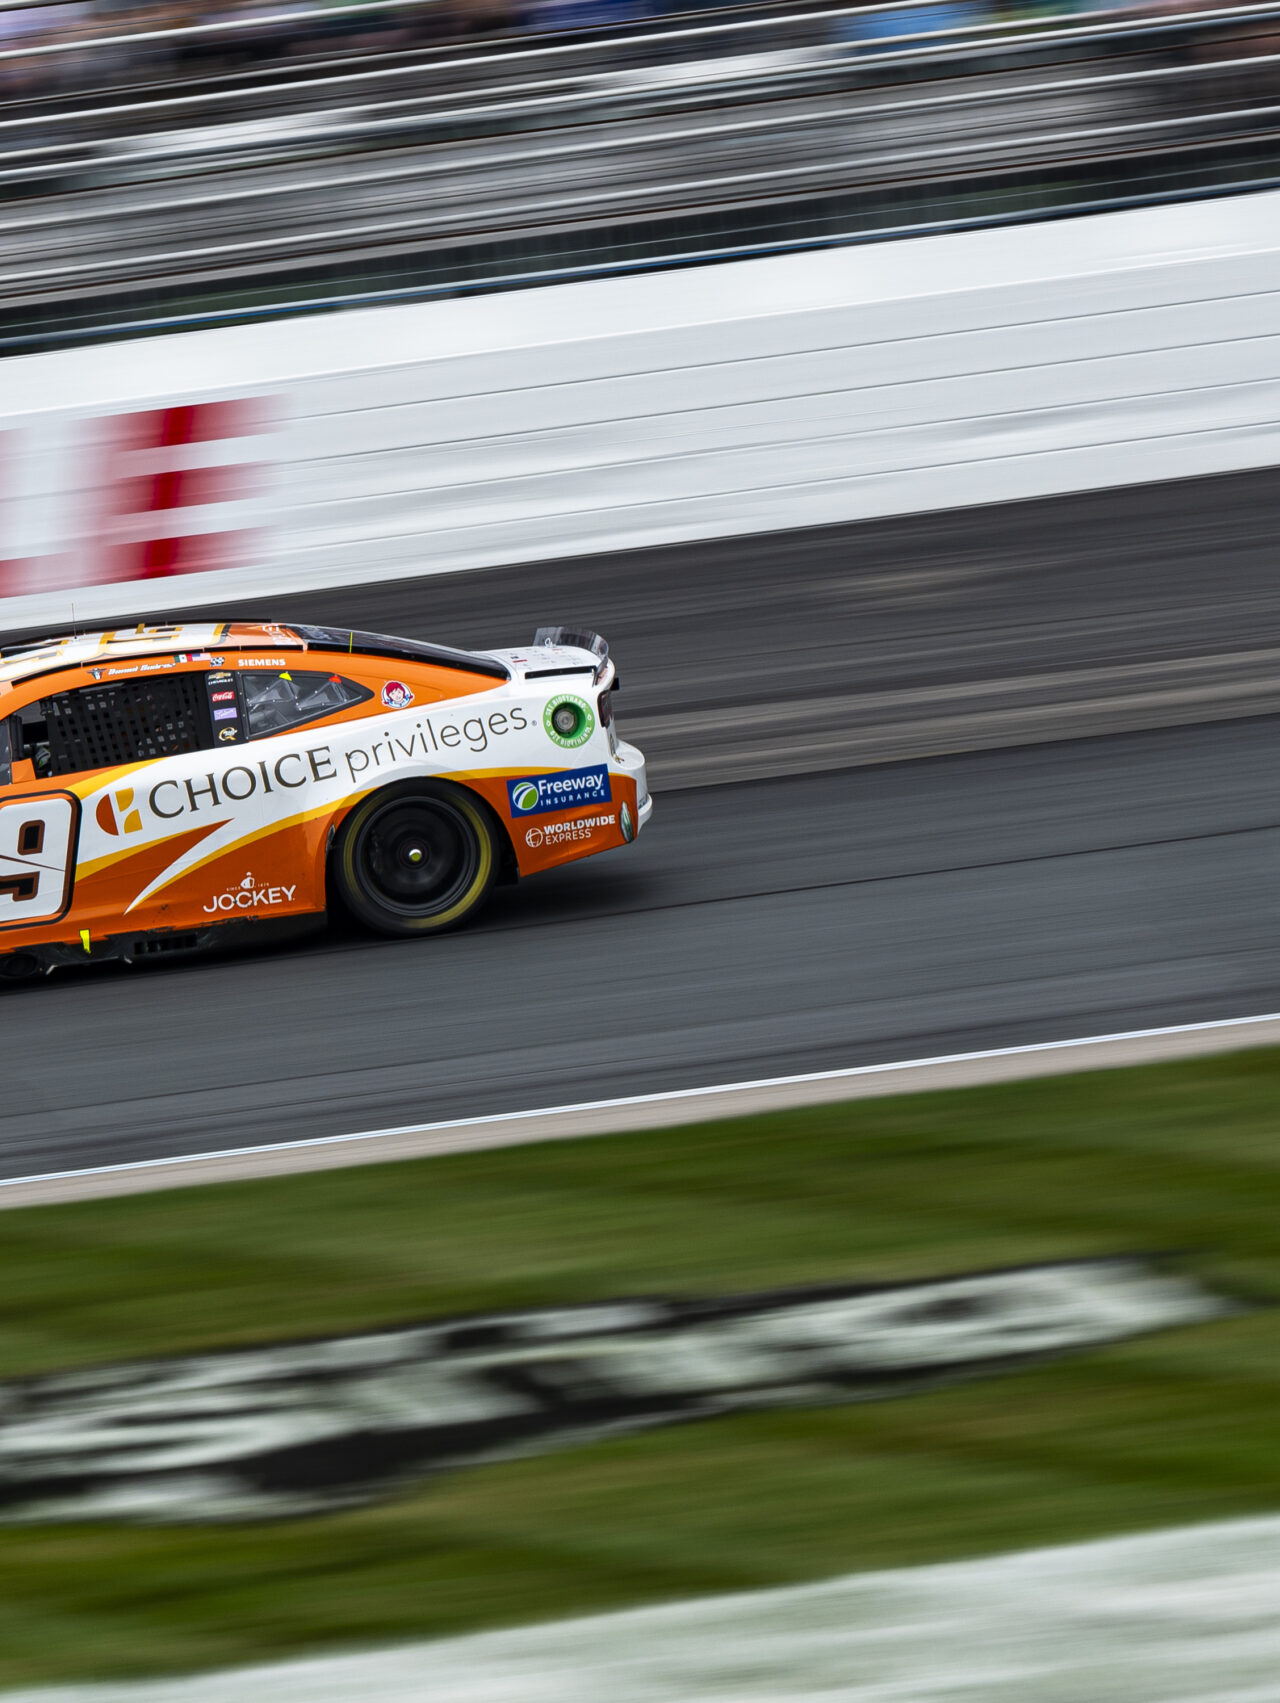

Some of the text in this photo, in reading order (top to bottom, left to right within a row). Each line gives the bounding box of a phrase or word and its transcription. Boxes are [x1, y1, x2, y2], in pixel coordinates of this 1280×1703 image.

[238, 658, 286, 667] SIEMENS
[149, 707, 528, 819] CHOICE privileges
[537, 773, 604, 796] Freeway
[540, 789, 606, 807] INSURANCE
[543, 815, 616, 835] WORLDWIDE
[545, 829, 591, 845] EXPRESS
[202, 884, 297, 913] JOCKEY
